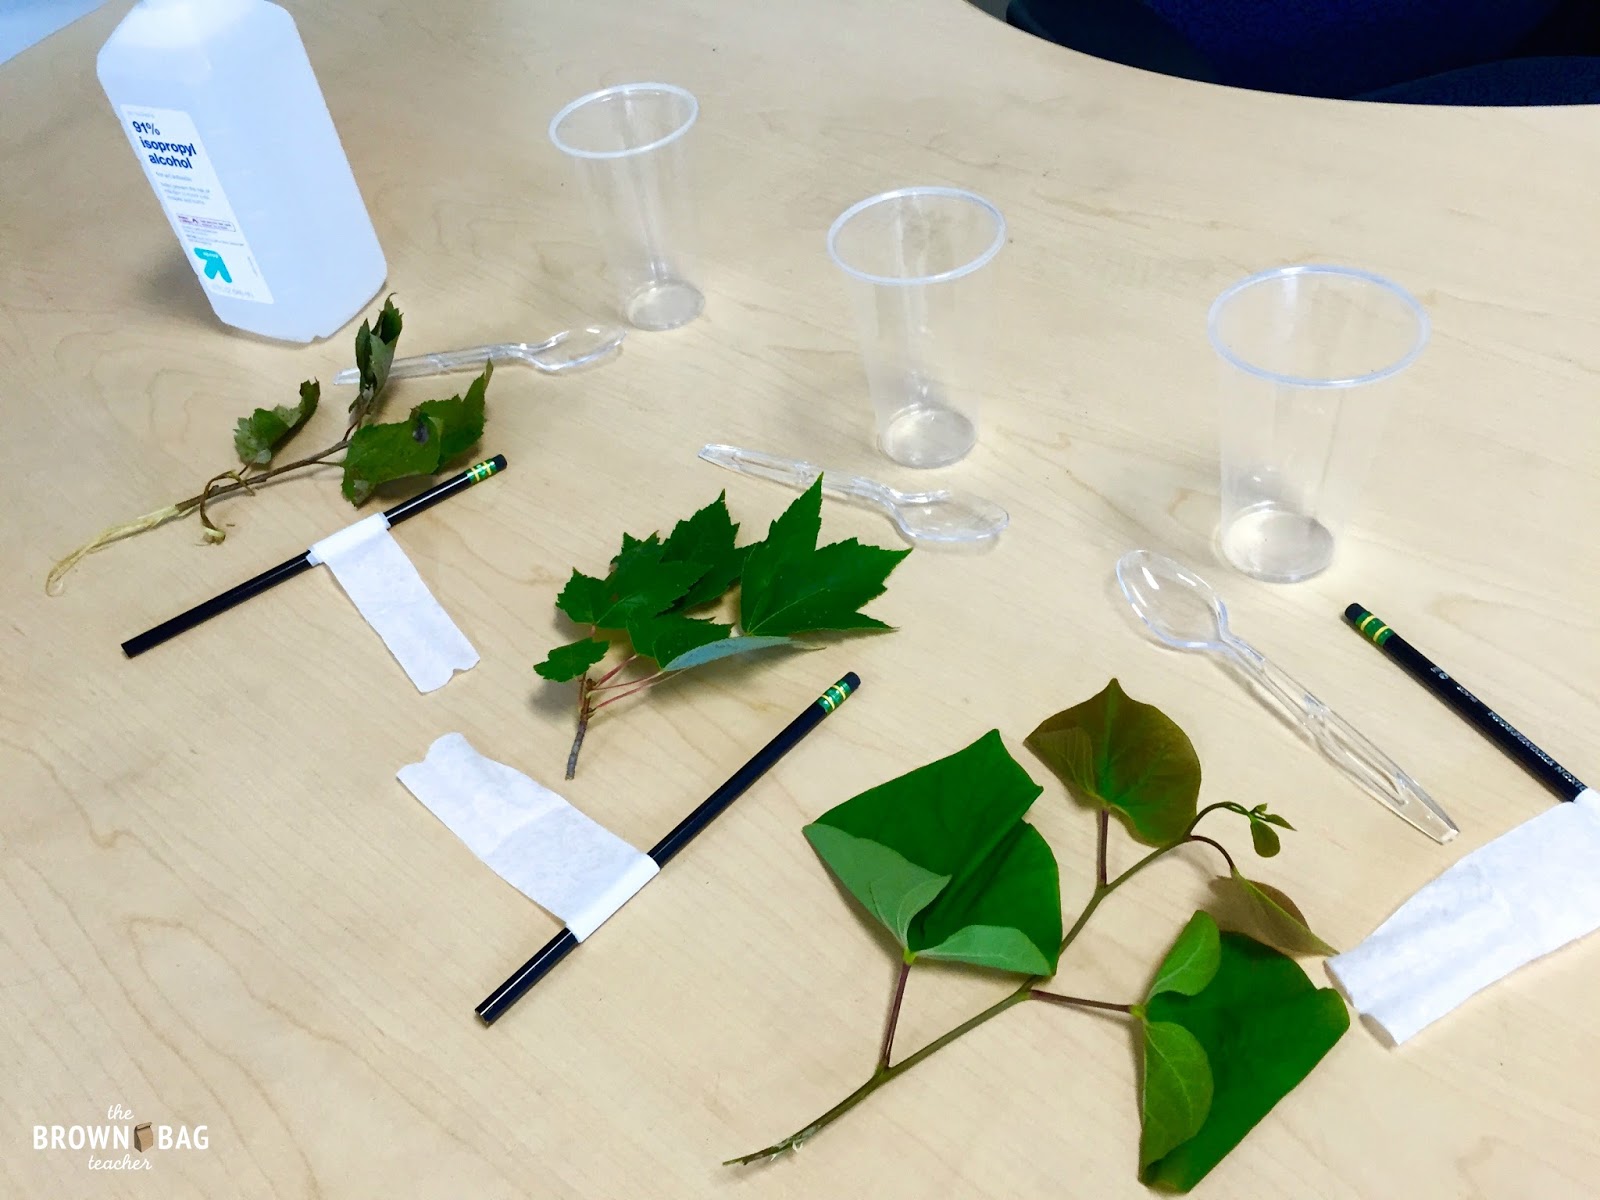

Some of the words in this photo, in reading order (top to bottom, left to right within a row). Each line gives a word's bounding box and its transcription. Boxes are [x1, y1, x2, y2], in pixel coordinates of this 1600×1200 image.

[132, 121, 161, 135] 91%
[139, 136, 197, 157] isopropyl
[148, 153, 193, 169] alcohol
